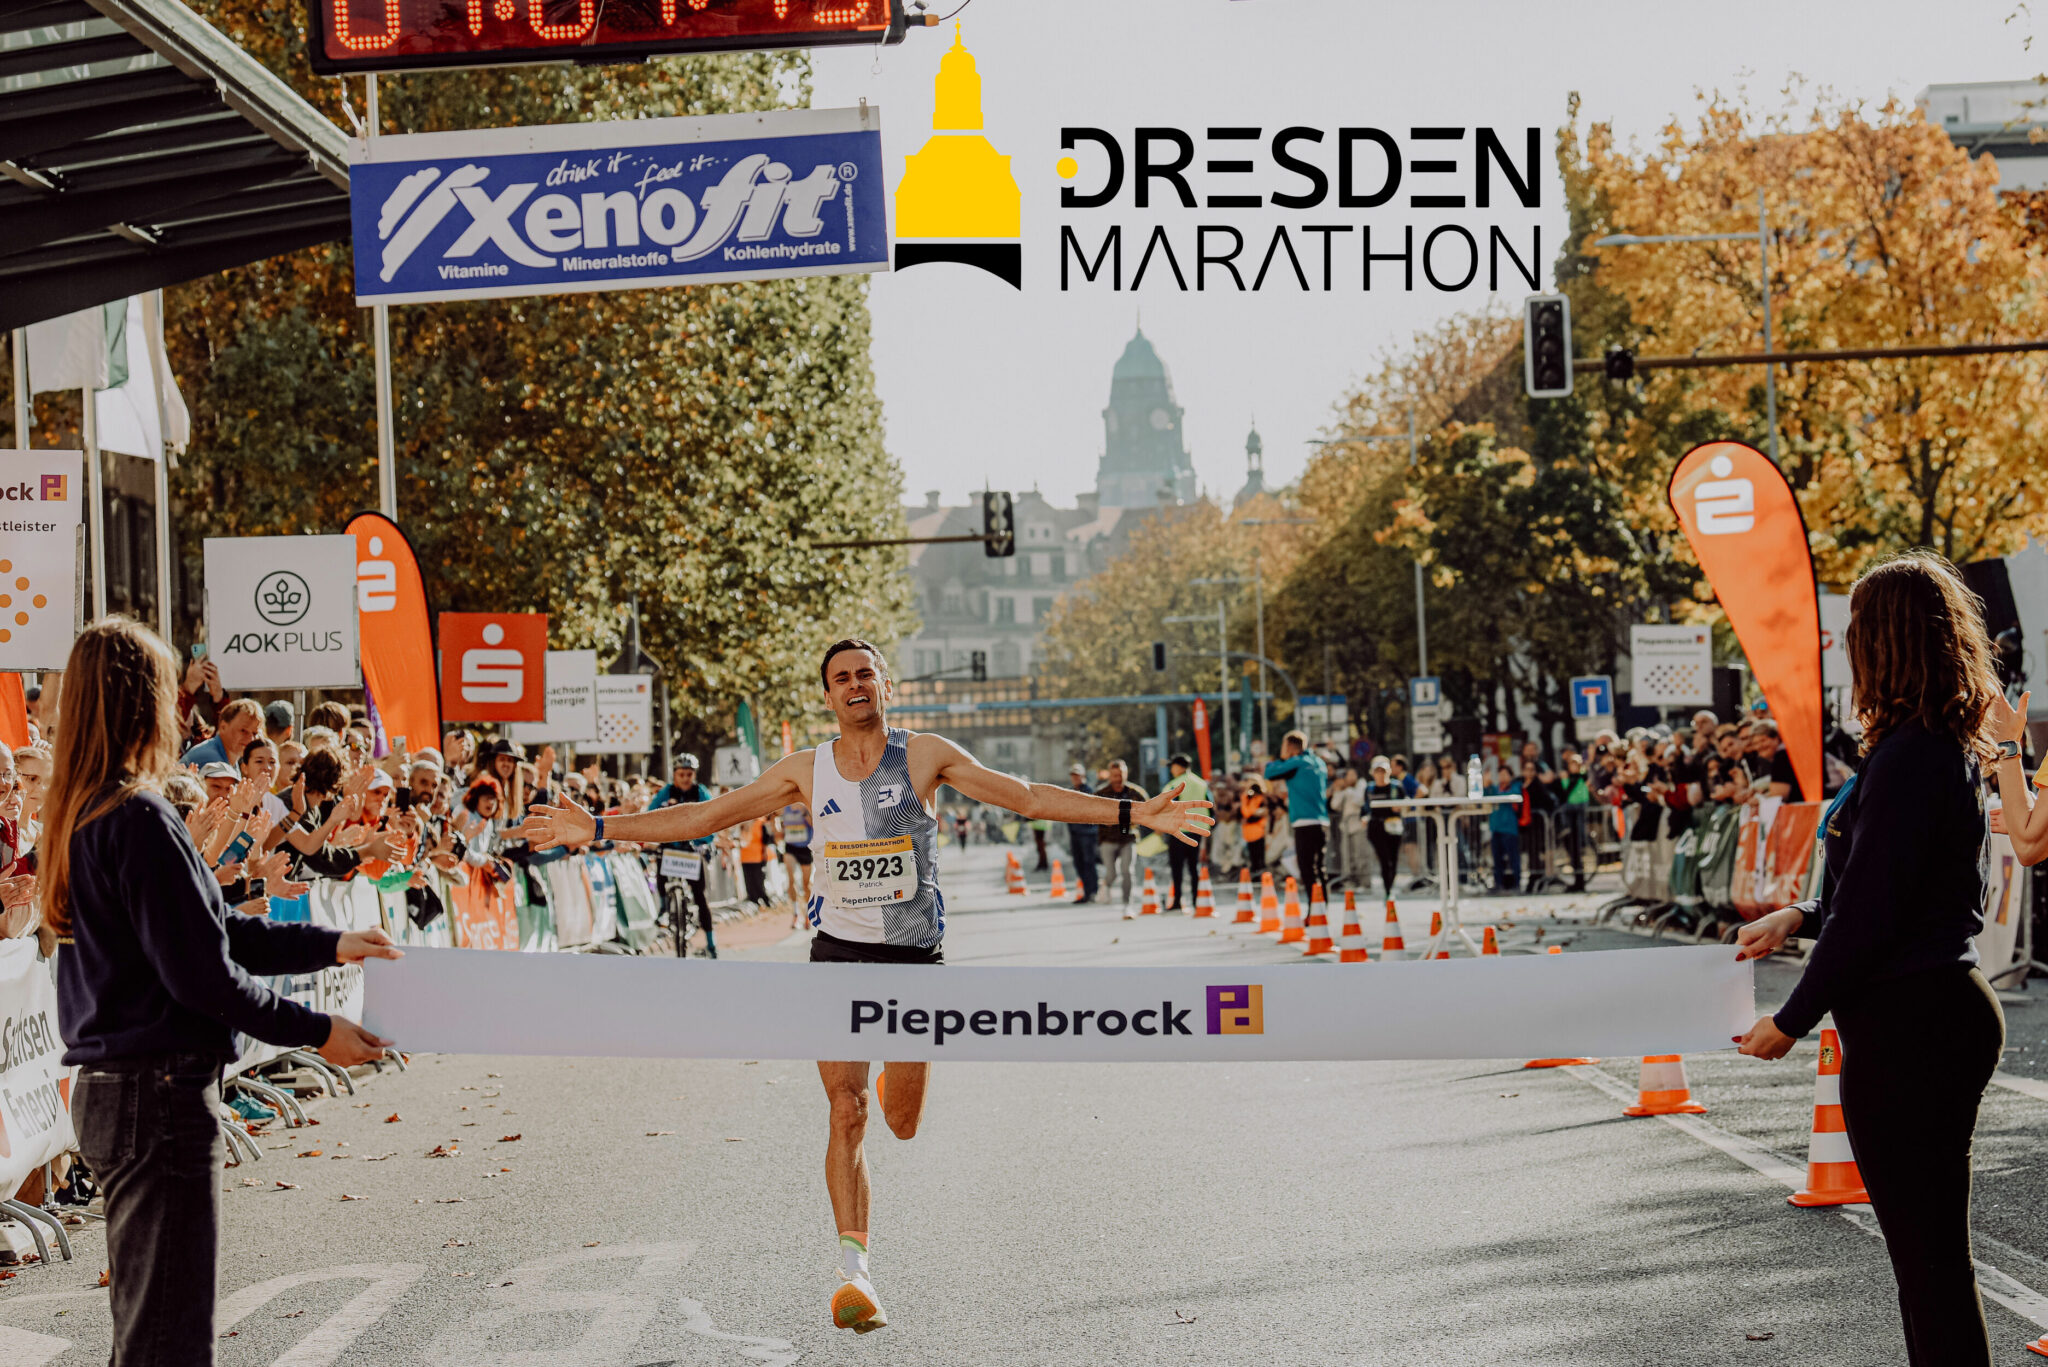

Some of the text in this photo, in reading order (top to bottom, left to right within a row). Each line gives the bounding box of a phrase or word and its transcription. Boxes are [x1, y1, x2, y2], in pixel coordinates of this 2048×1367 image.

[546, 158, 602, 187] drink
[634, 161, 684, 201] feel
[723, 241, 841, 261] Kohlenhydrate
[438, 263, 509, 280] Vitamine
[562, 253, 668, 272] Mineralstoffe
[0, 520, 57, 532] tleister
[547, 686, 589, 695] achsen
[550, 696, 586, 706] nergie
[840, 839, 905, 850] DRESDEN-MARATHON
[836, 856, 904, 881] 23923
[841, 893, 893, 906] Piepenbrock
[850, 999, 1193, 1046] Piepenbrock
